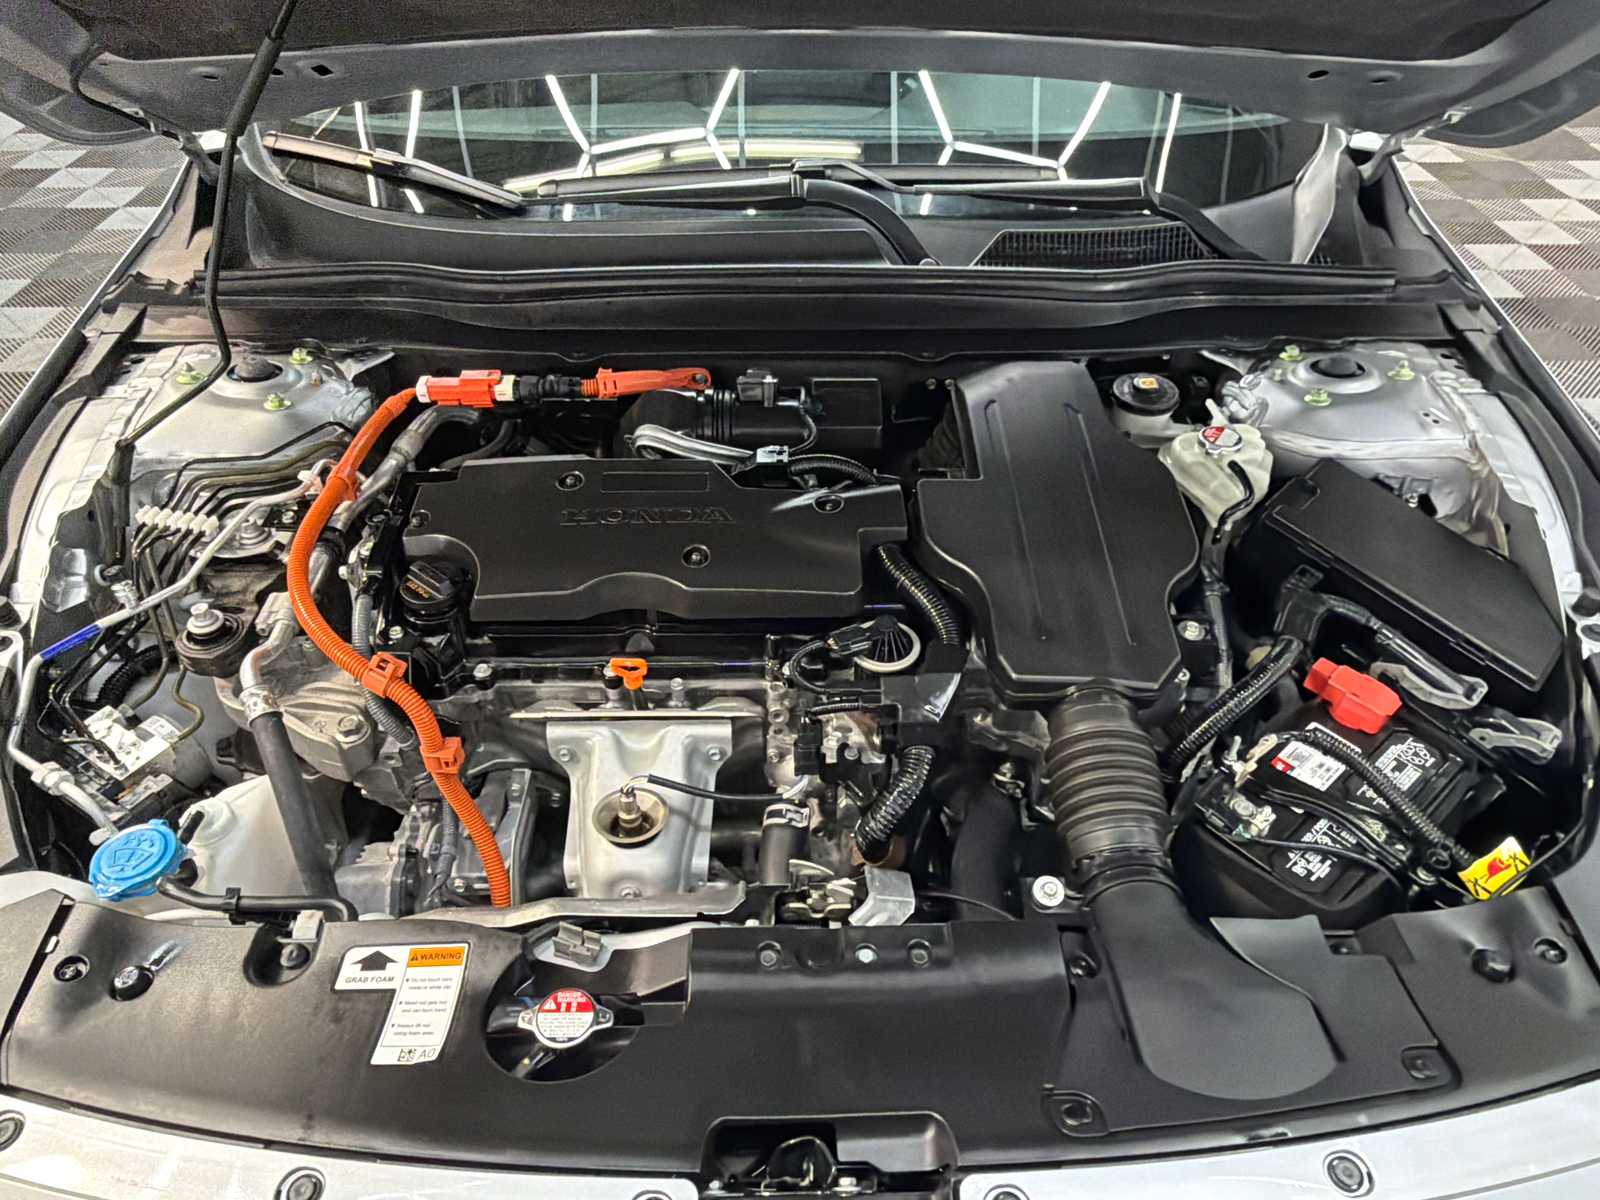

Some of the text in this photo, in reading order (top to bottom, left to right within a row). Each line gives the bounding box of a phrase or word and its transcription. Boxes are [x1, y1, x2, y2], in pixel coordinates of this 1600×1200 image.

[560, 507, 737, 525] HONDA
[420, 952, 462, 961] WARNING
[345, 976, 369, 984] GRAB
